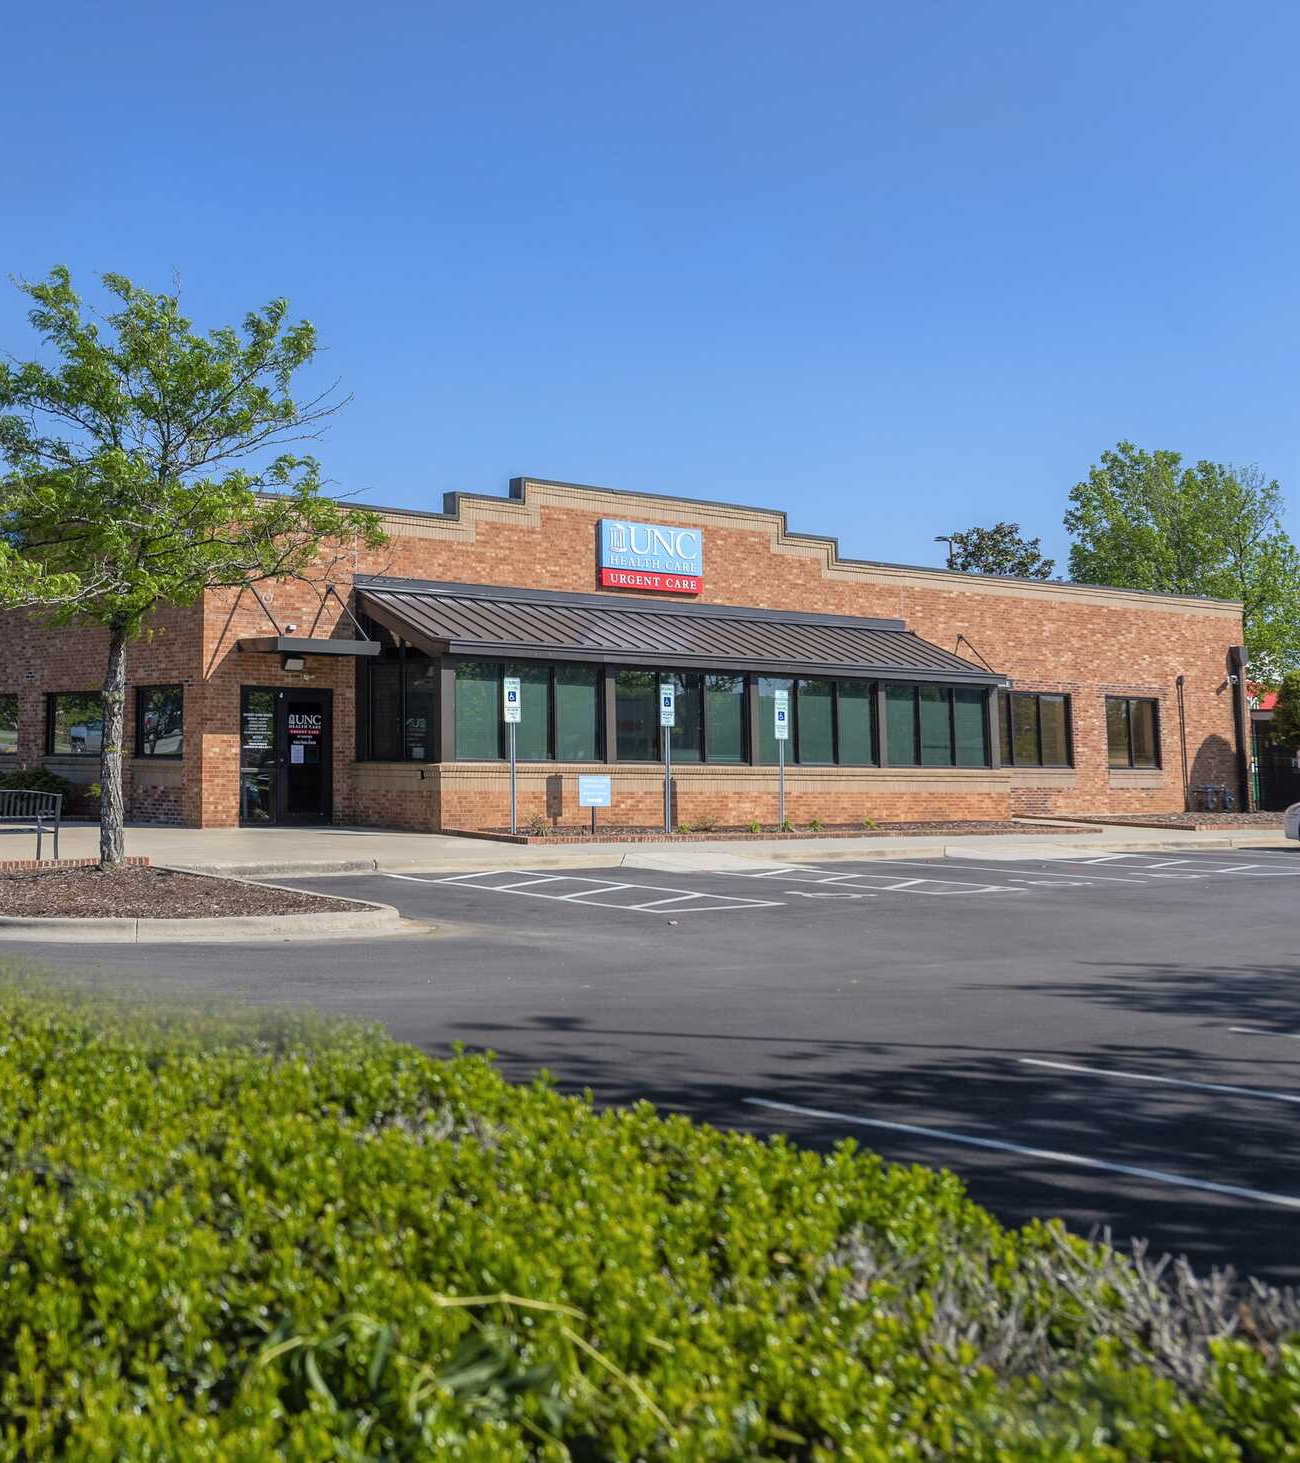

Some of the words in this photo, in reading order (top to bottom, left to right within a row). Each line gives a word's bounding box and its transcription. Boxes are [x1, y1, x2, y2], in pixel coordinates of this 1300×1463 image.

[628, 526, 697, 560] UNC
[610, 555, 660, 569] HEALTH
[665, 561, 697, 573] CARE
[610, 573, 660, 586] URGENT
[665, 578, 697, 590] CARE
[295, 714, 322, 725] UNC
